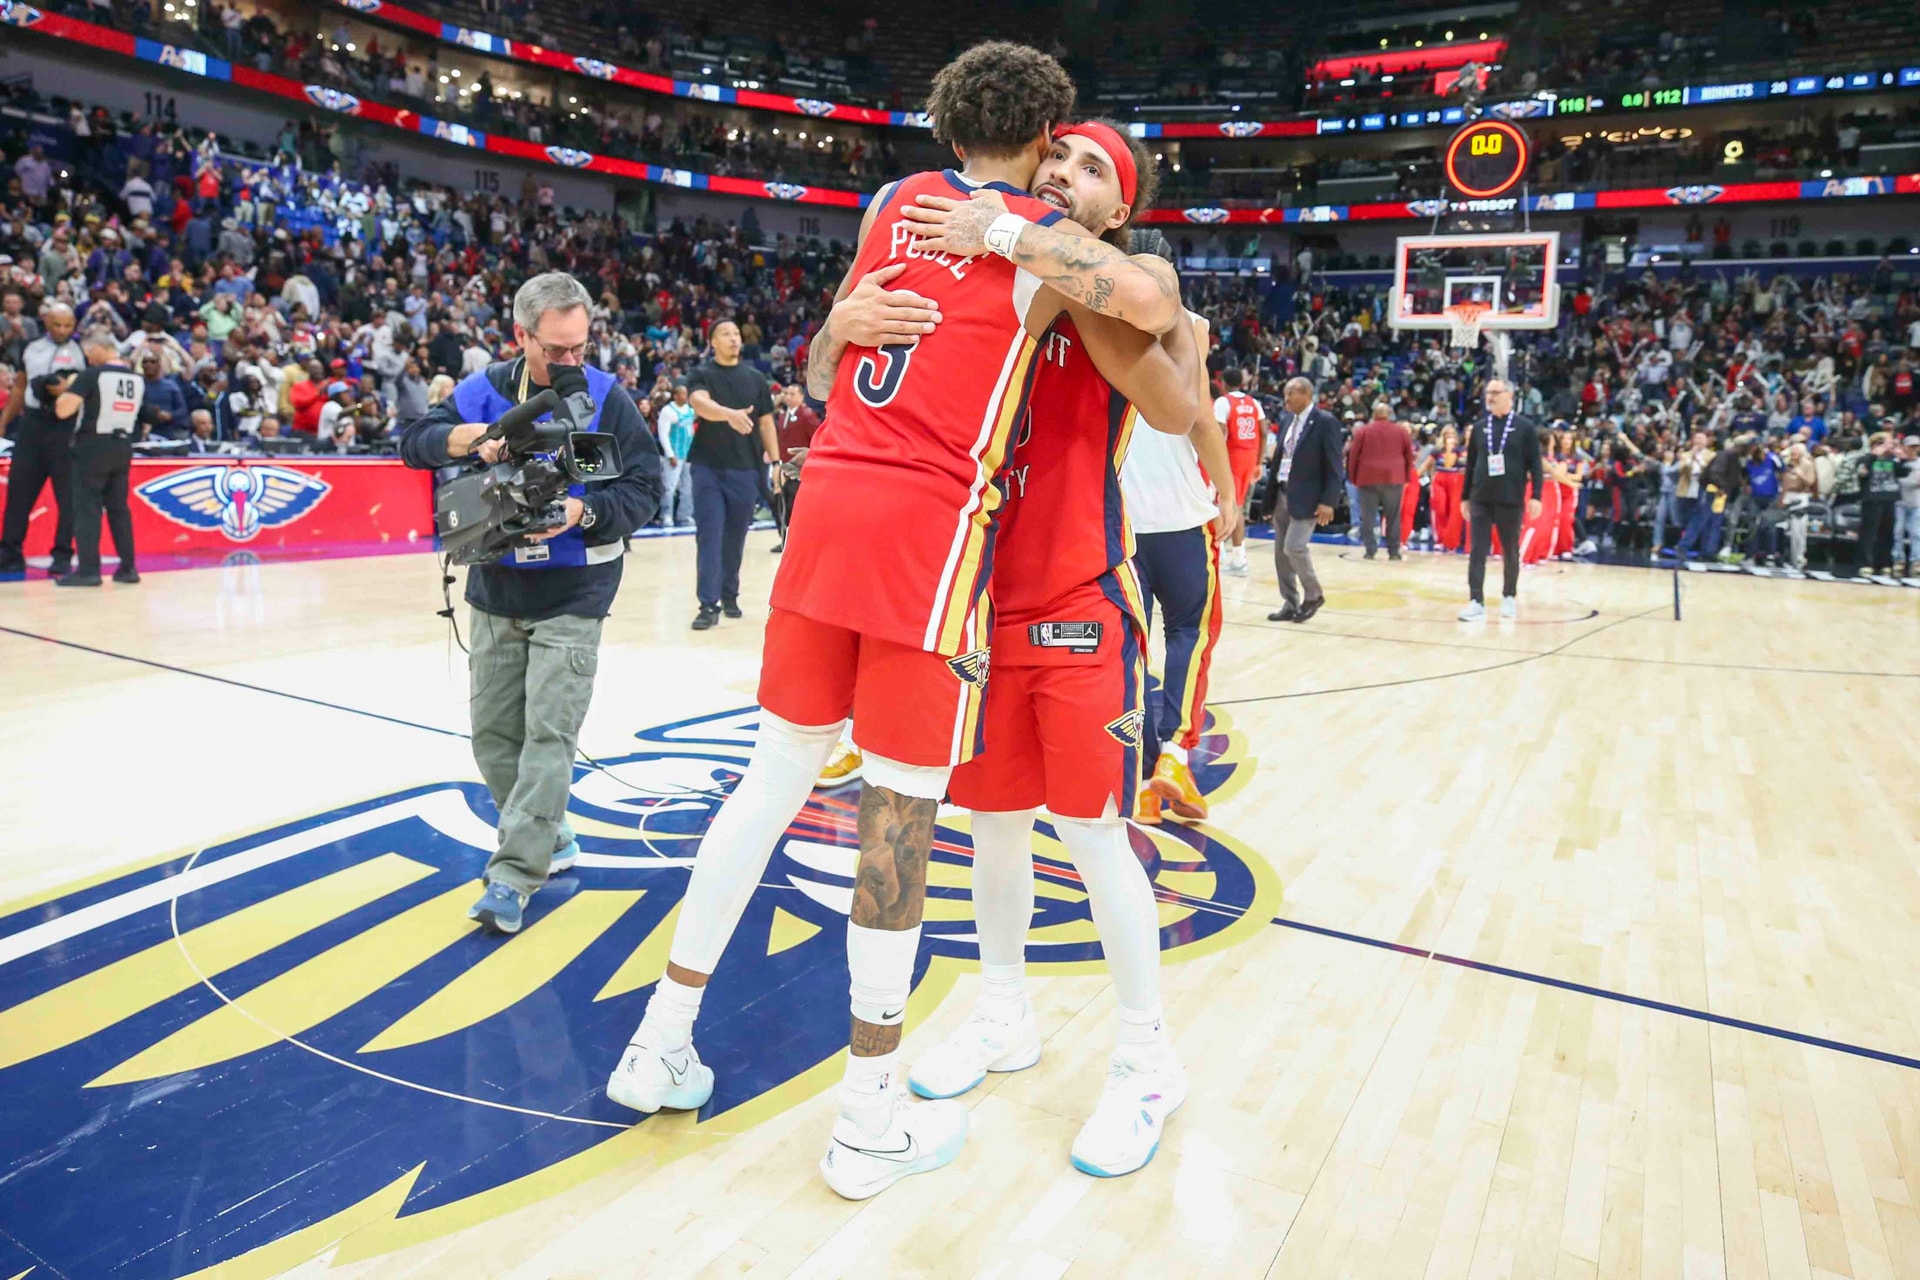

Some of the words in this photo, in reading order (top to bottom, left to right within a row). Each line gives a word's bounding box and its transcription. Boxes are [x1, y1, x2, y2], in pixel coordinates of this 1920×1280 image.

[144, 91, 176, 119] 114
[1558, 97, 1585, 113] 116
[1653, 89, 1682, 105] 112
[1471, 133, 1503, 156] 0.0
[474, 169, 500, 193] 115
[1467, 199, 1517, 212] TISSOT
[853, 289, 922, 408] 3
[116, 379, 135, 399] 48
[1237, 417, 1256, 440] 22
[449, 511, 459, 527] 8
